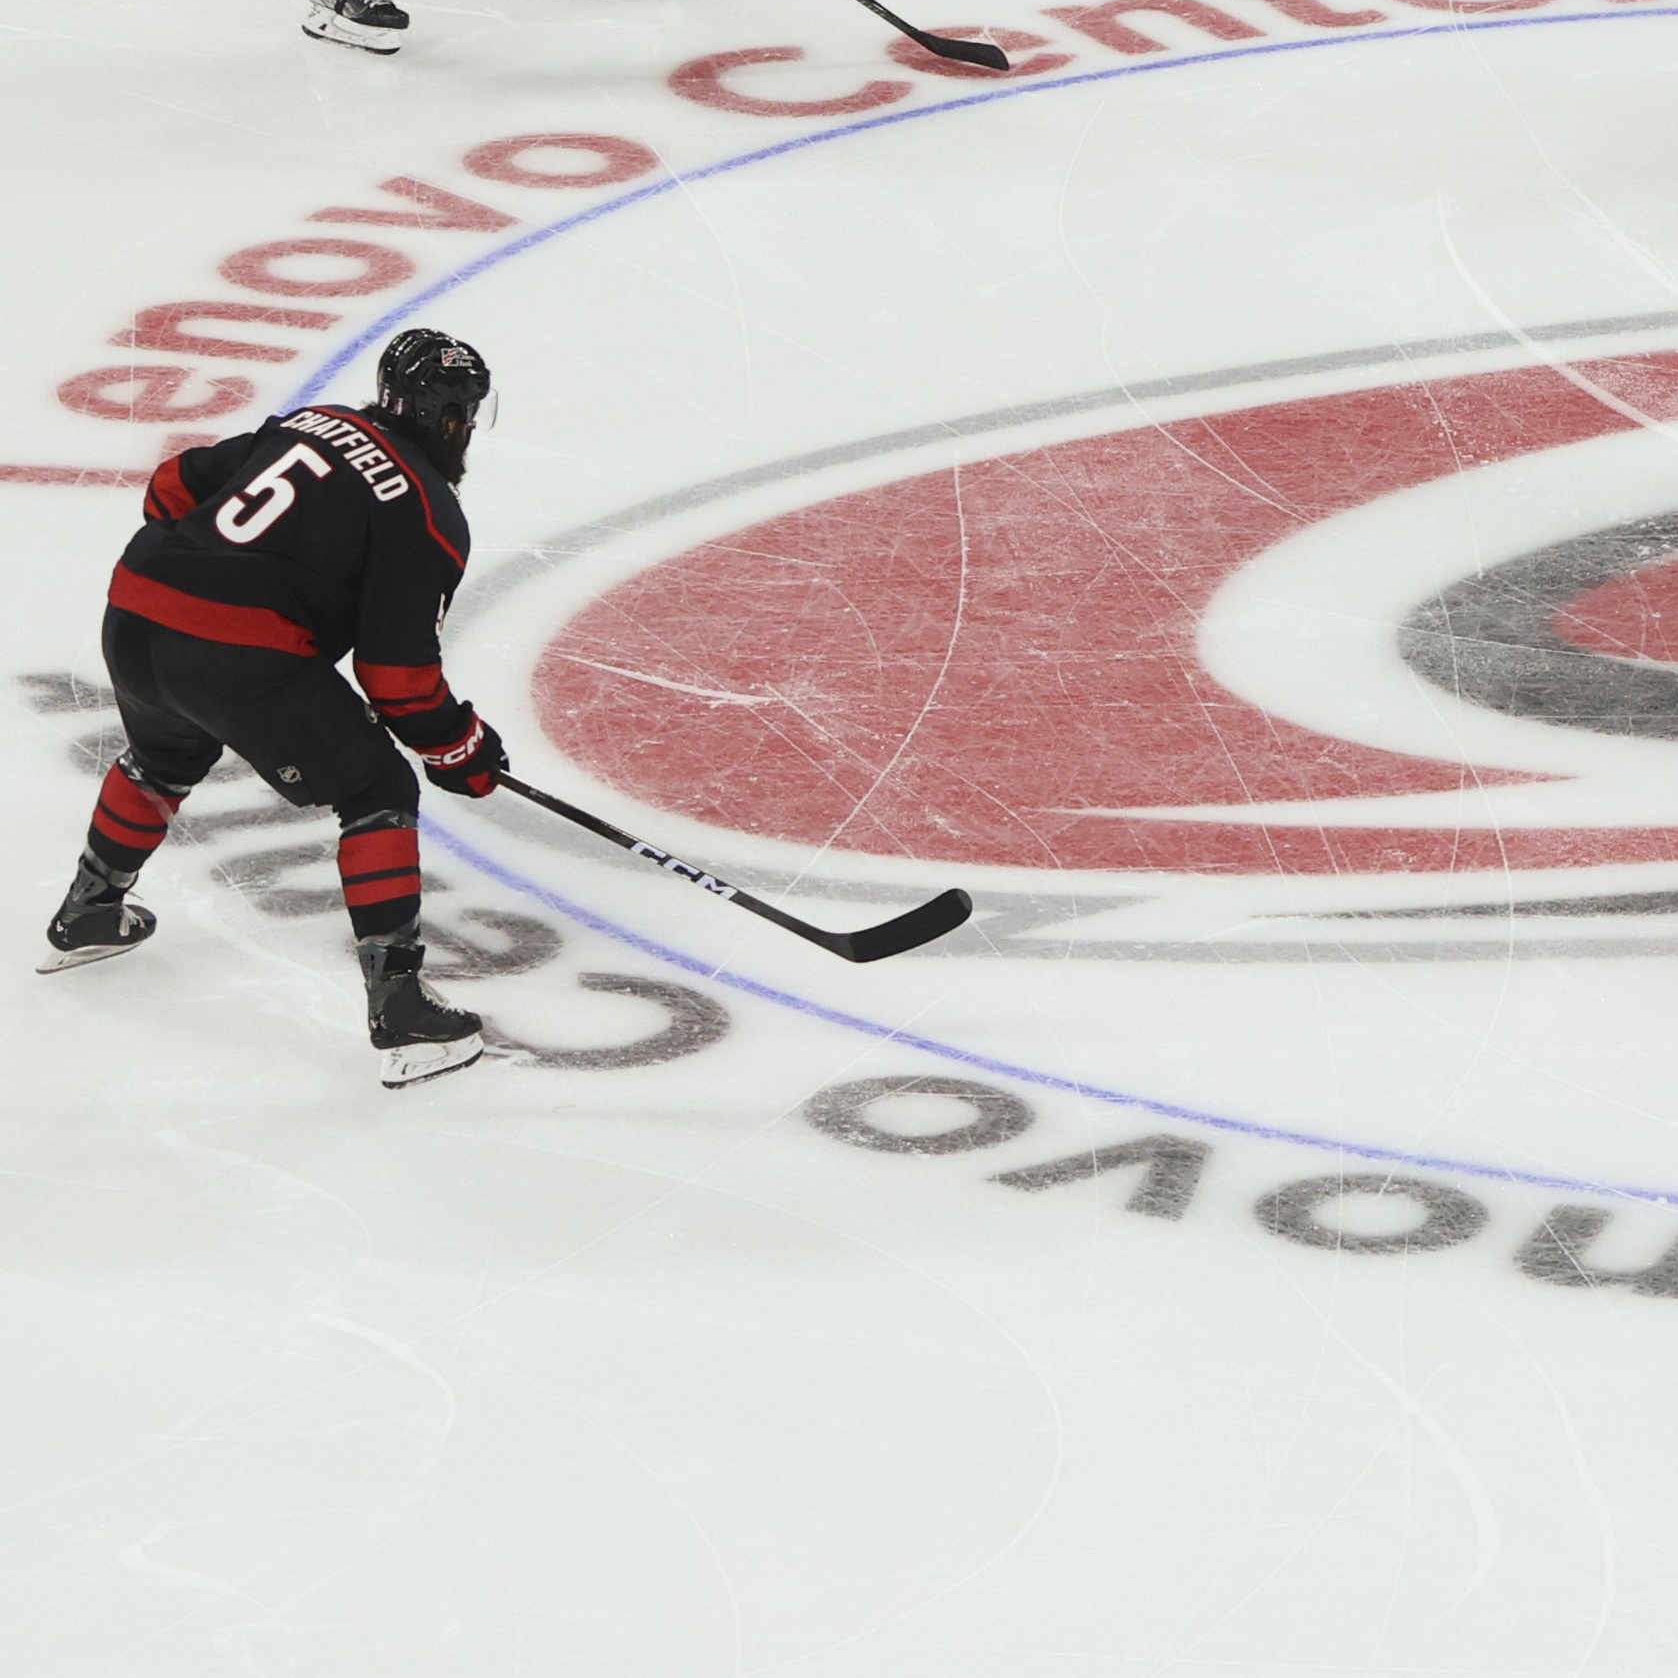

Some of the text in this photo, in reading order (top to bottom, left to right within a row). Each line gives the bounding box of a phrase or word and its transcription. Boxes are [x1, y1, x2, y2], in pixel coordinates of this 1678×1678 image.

[214, 442, 332, 545] 5
[279, 409, 410, 503] CHATFIELD
[420, 721, 485, 766] CCM
[630, 842, 743, 902] CCM
